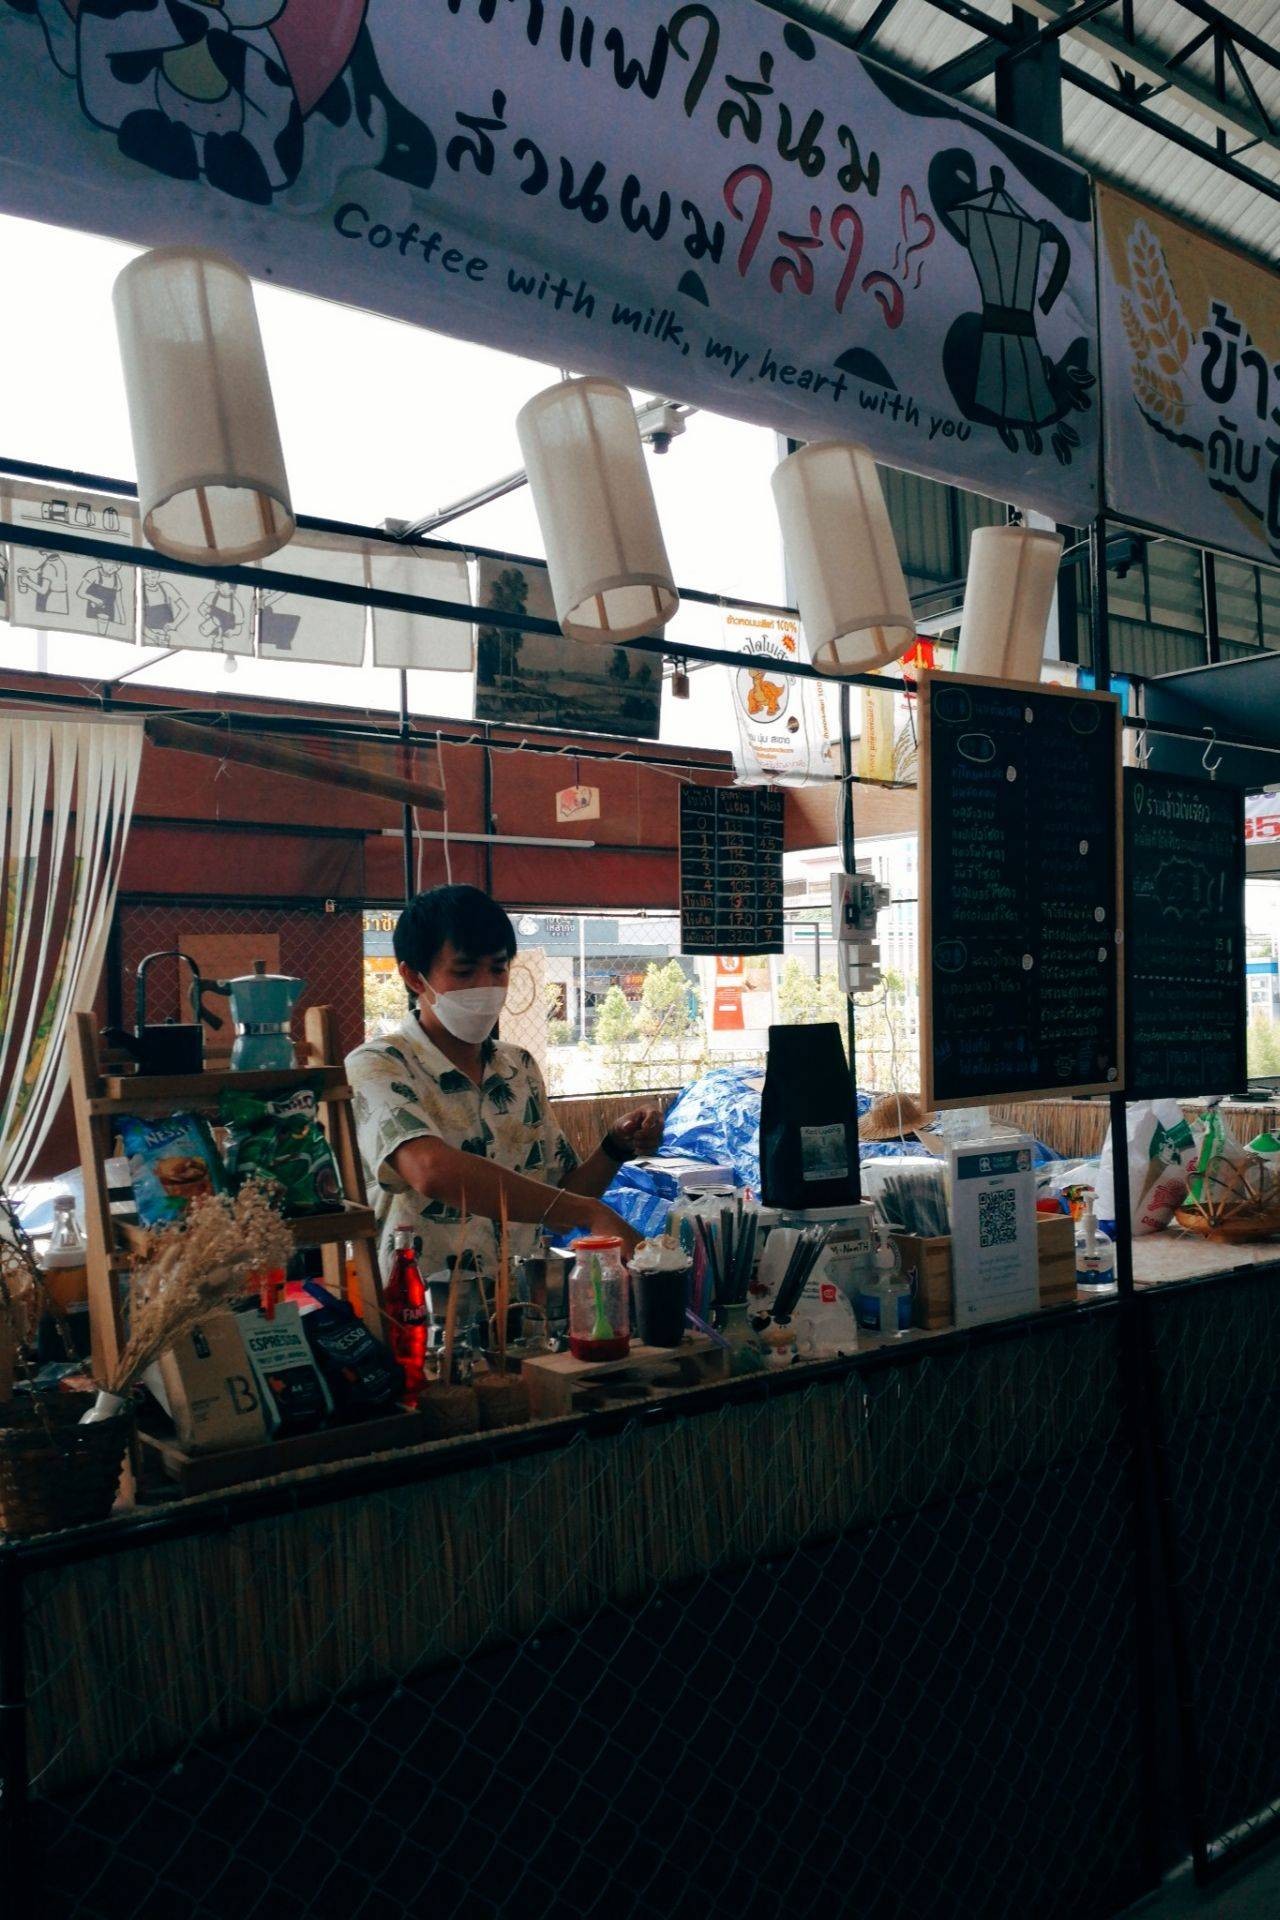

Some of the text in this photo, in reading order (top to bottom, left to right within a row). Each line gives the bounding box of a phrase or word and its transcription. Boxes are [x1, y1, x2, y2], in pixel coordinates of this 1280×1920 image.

[447, 0, 881, 197] าแฟใส่นม
[333, 202, 972, 441] Coffee with milk, my heart with you
[1201, 301, 1280, 428] ข้า
[224, 1375, 258, 1415] B
